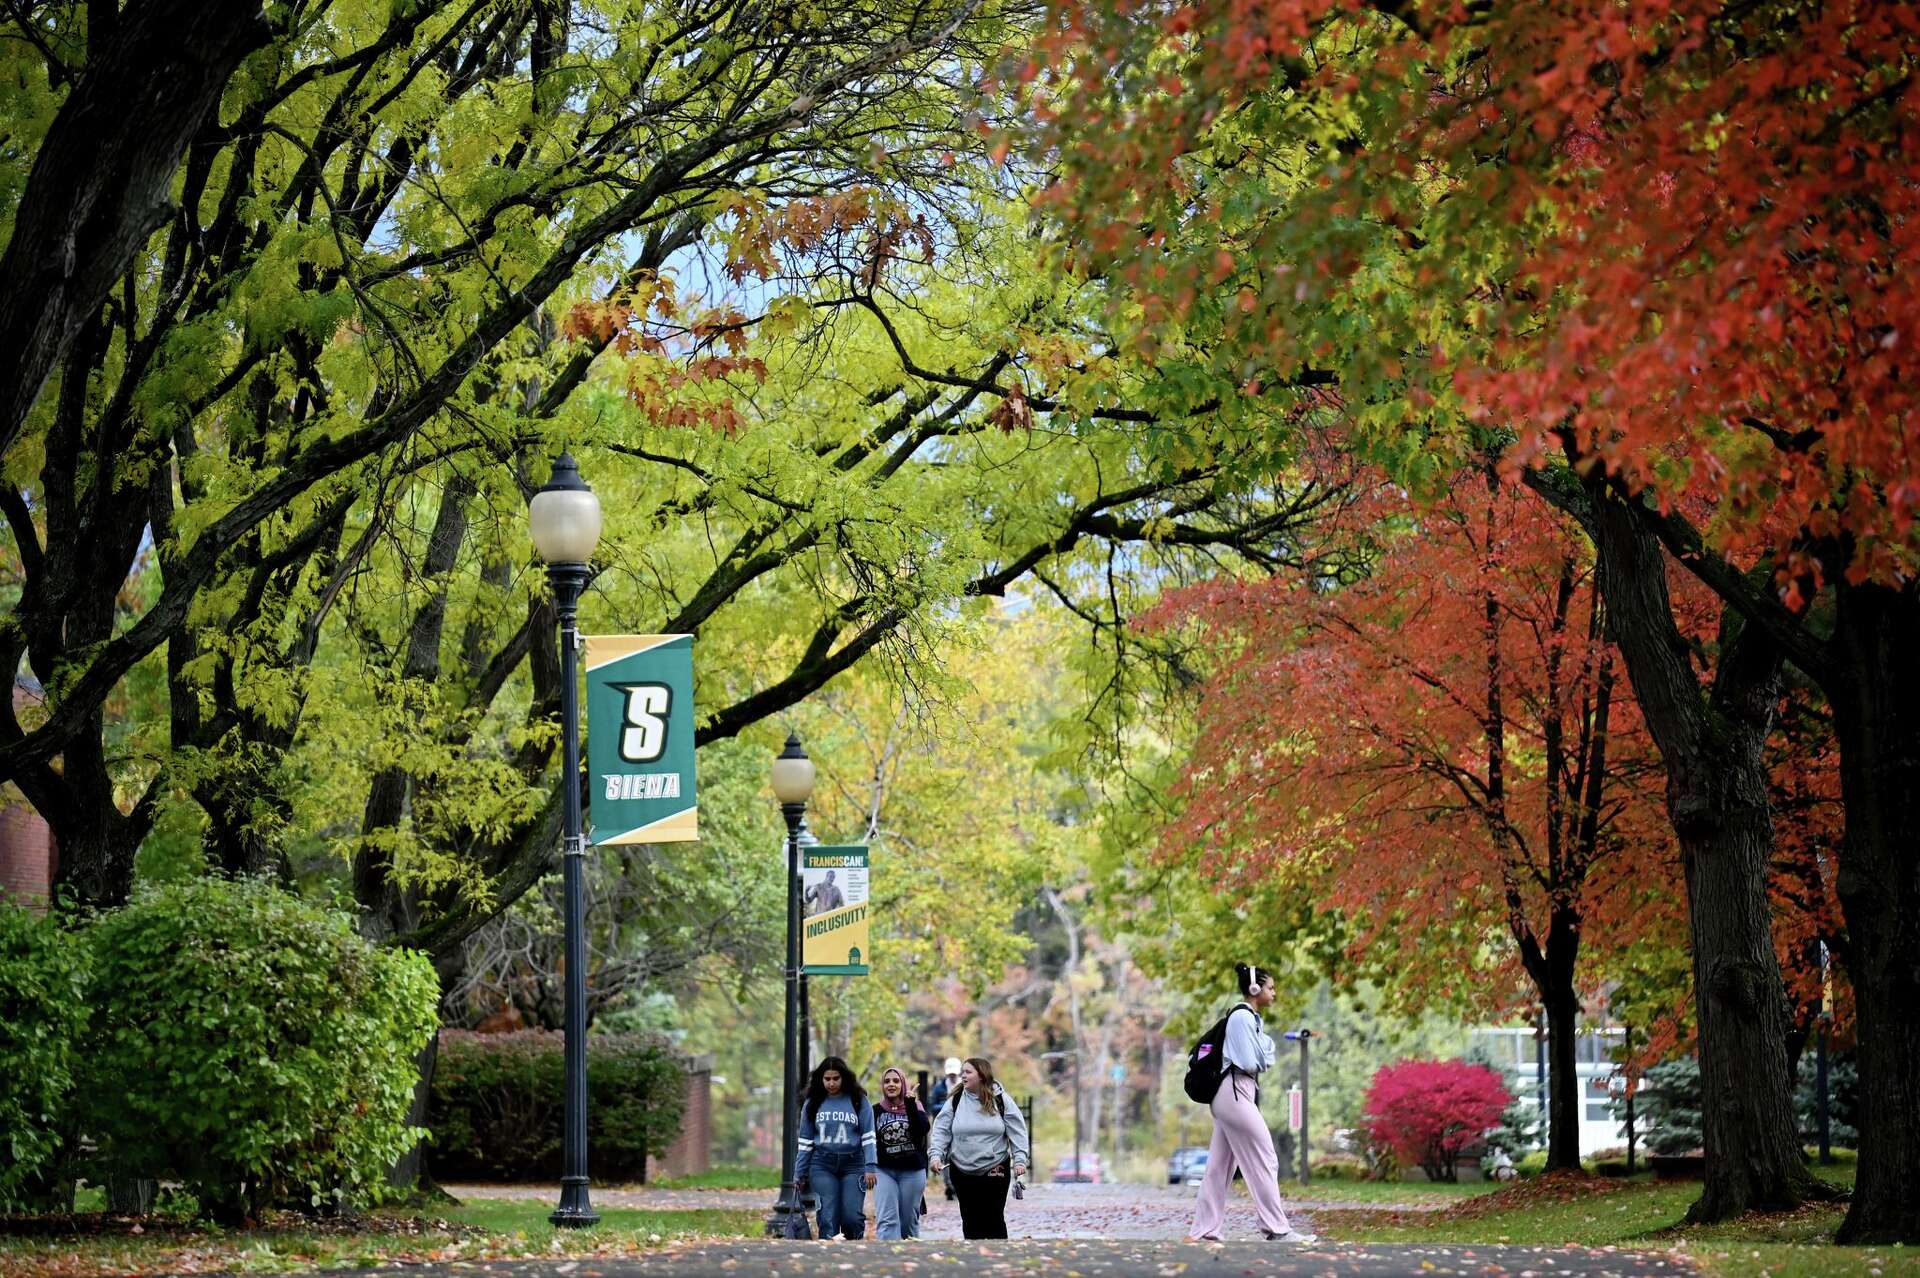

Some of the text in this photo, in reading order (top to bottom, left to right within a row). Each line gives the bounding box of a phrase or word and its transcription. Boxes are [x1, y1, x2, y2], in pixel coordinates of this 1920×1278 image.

[606, 681, 673, 764] S
[601, 773, 680, 800] SIENA
[809, 855, 864, 867] FRANCISCAN!
[806, 905, 867, 939] INCLUSIVITY
[815, 1111, 831, 1123] EST
[818, 1122, 848, 1144] LA
